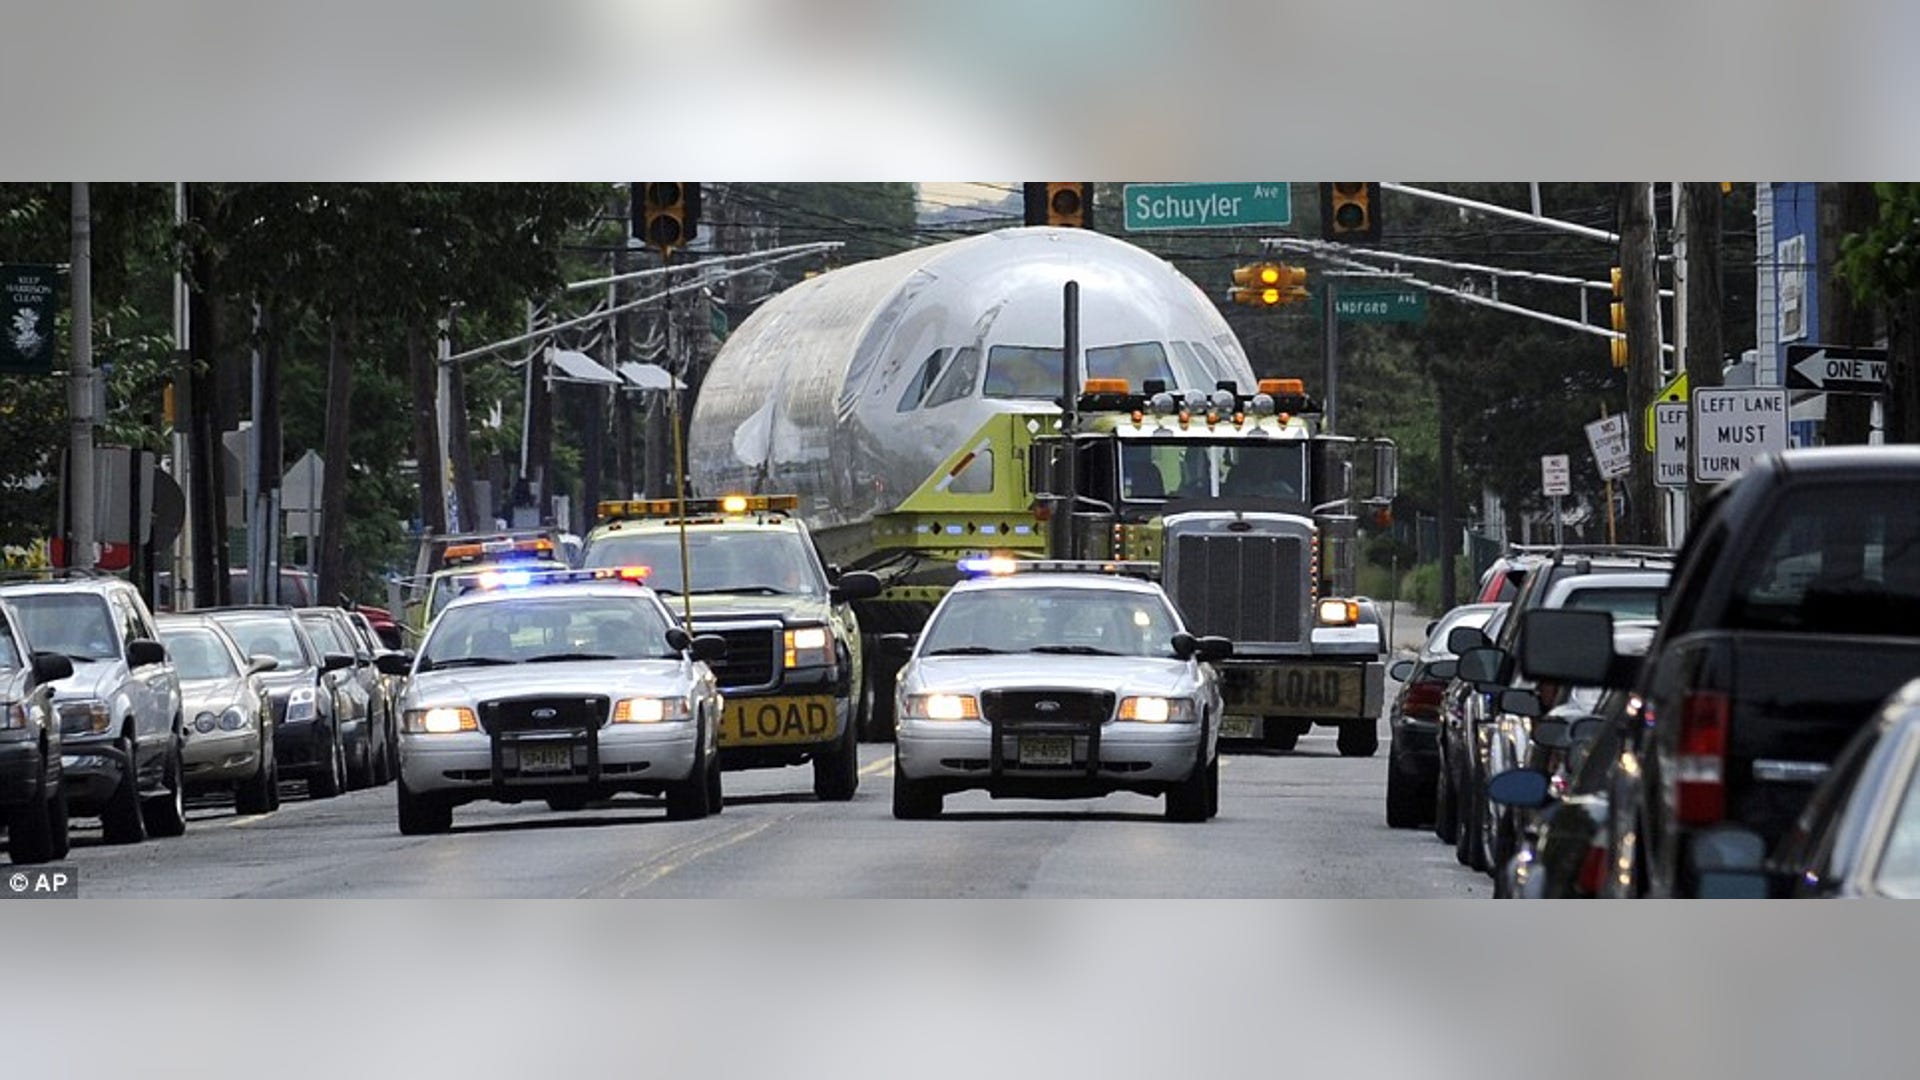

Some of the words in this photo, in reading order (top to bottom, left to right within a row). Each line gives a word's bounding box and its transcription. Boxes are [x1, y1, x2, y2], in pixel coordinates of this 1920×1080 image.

[1136, 193, 1242, 224] Schuyler
[1254, 184, 1279, 199] Ave
[1826, 360, 1863, 379] ONE
[1700, 397, 1735, 413] LEFT
[1744, 396, 1783, 412] LANE
[1717, 424, 1767, 444] MUST
[1660, 463, 1684, 477] TUR
[1701, 456, 1741, 472] TURN
[1271, 668, 1341, 709] LOAD
[737, 702, 829, 738] LOAD
